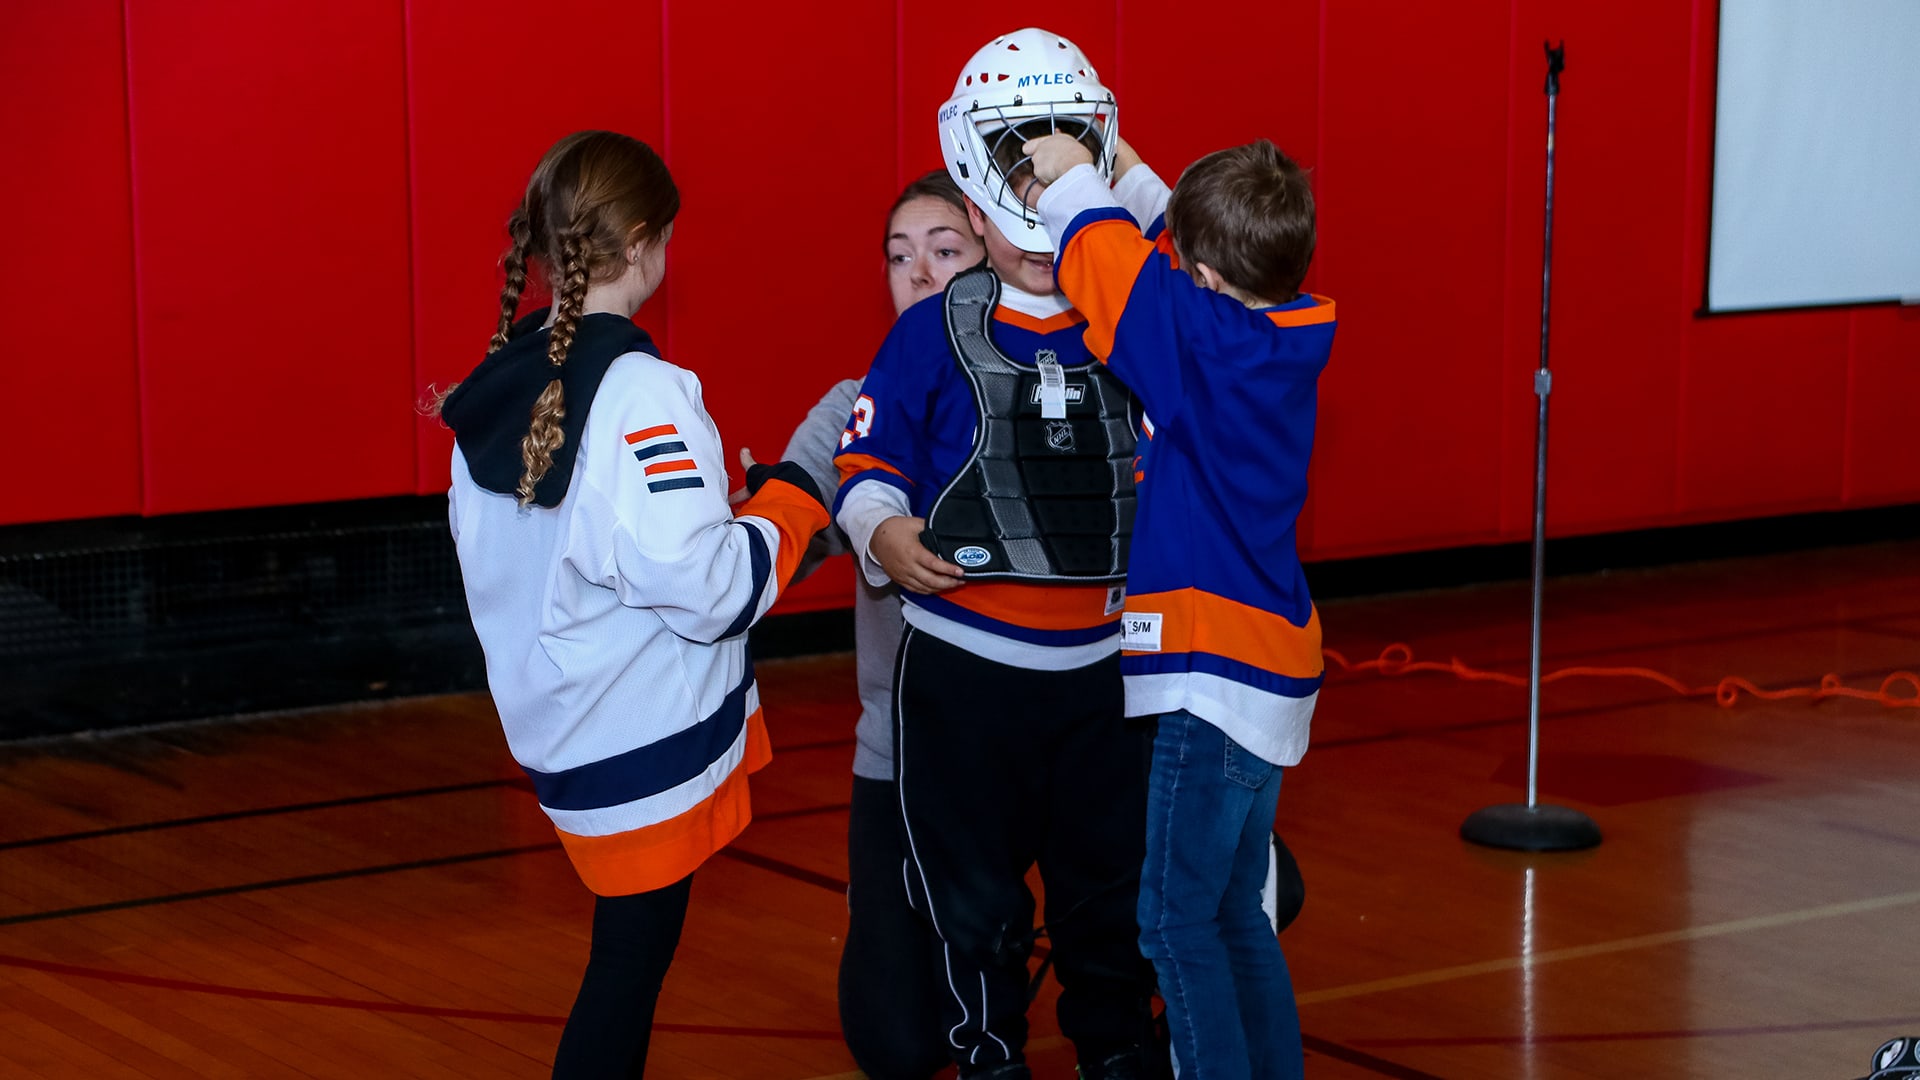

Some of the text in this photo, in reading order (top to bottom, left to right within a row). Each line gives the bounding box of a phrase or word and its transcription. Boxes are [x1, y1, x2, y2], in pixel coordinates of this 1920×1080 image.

[1017, 73, 1074, 88] MYLEC
[1053, 430, 1068, 444] NHL
[1132, 621, 1151, 633] S/M
